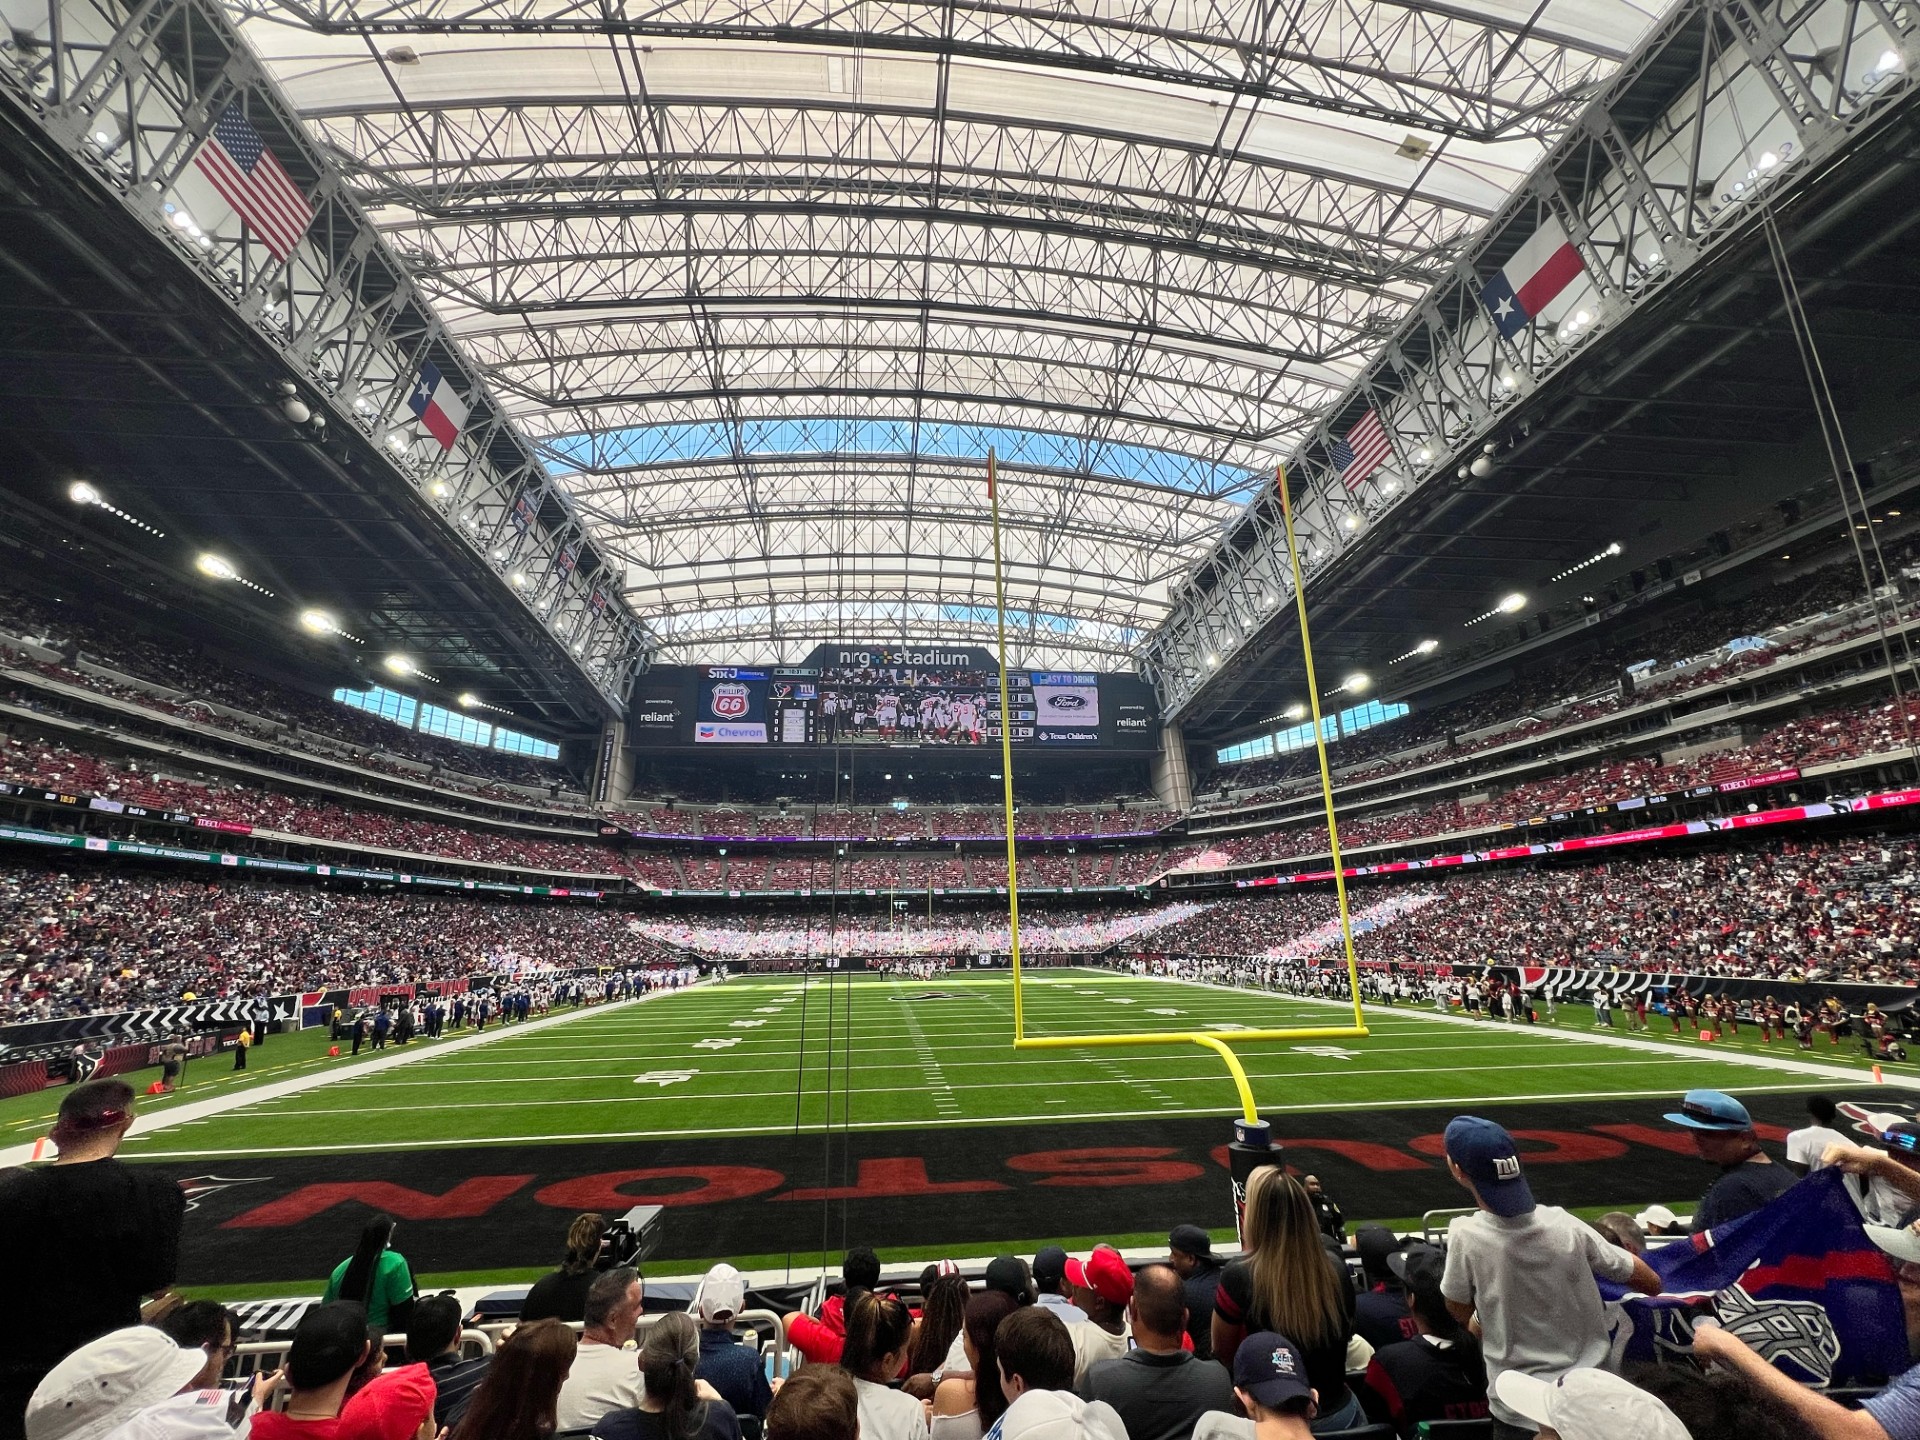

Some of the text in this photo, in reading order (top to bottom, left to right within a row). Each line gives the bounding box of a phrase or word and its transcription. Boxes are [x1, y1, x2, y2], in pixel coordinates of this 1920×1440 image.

[839, 650, 969, 668] nrg stadium
[1063, 675, 1072, 684] TO
[1072, 676, 1095, 684] DRINK
[719, 698, 742, 710] 66
[1054, 696, 1079, 707] Ford
[640, 712, 674, 722] reliant
[1116, 718, 1147, 727] reliant
[718, 727, 763, 737] Chevron
